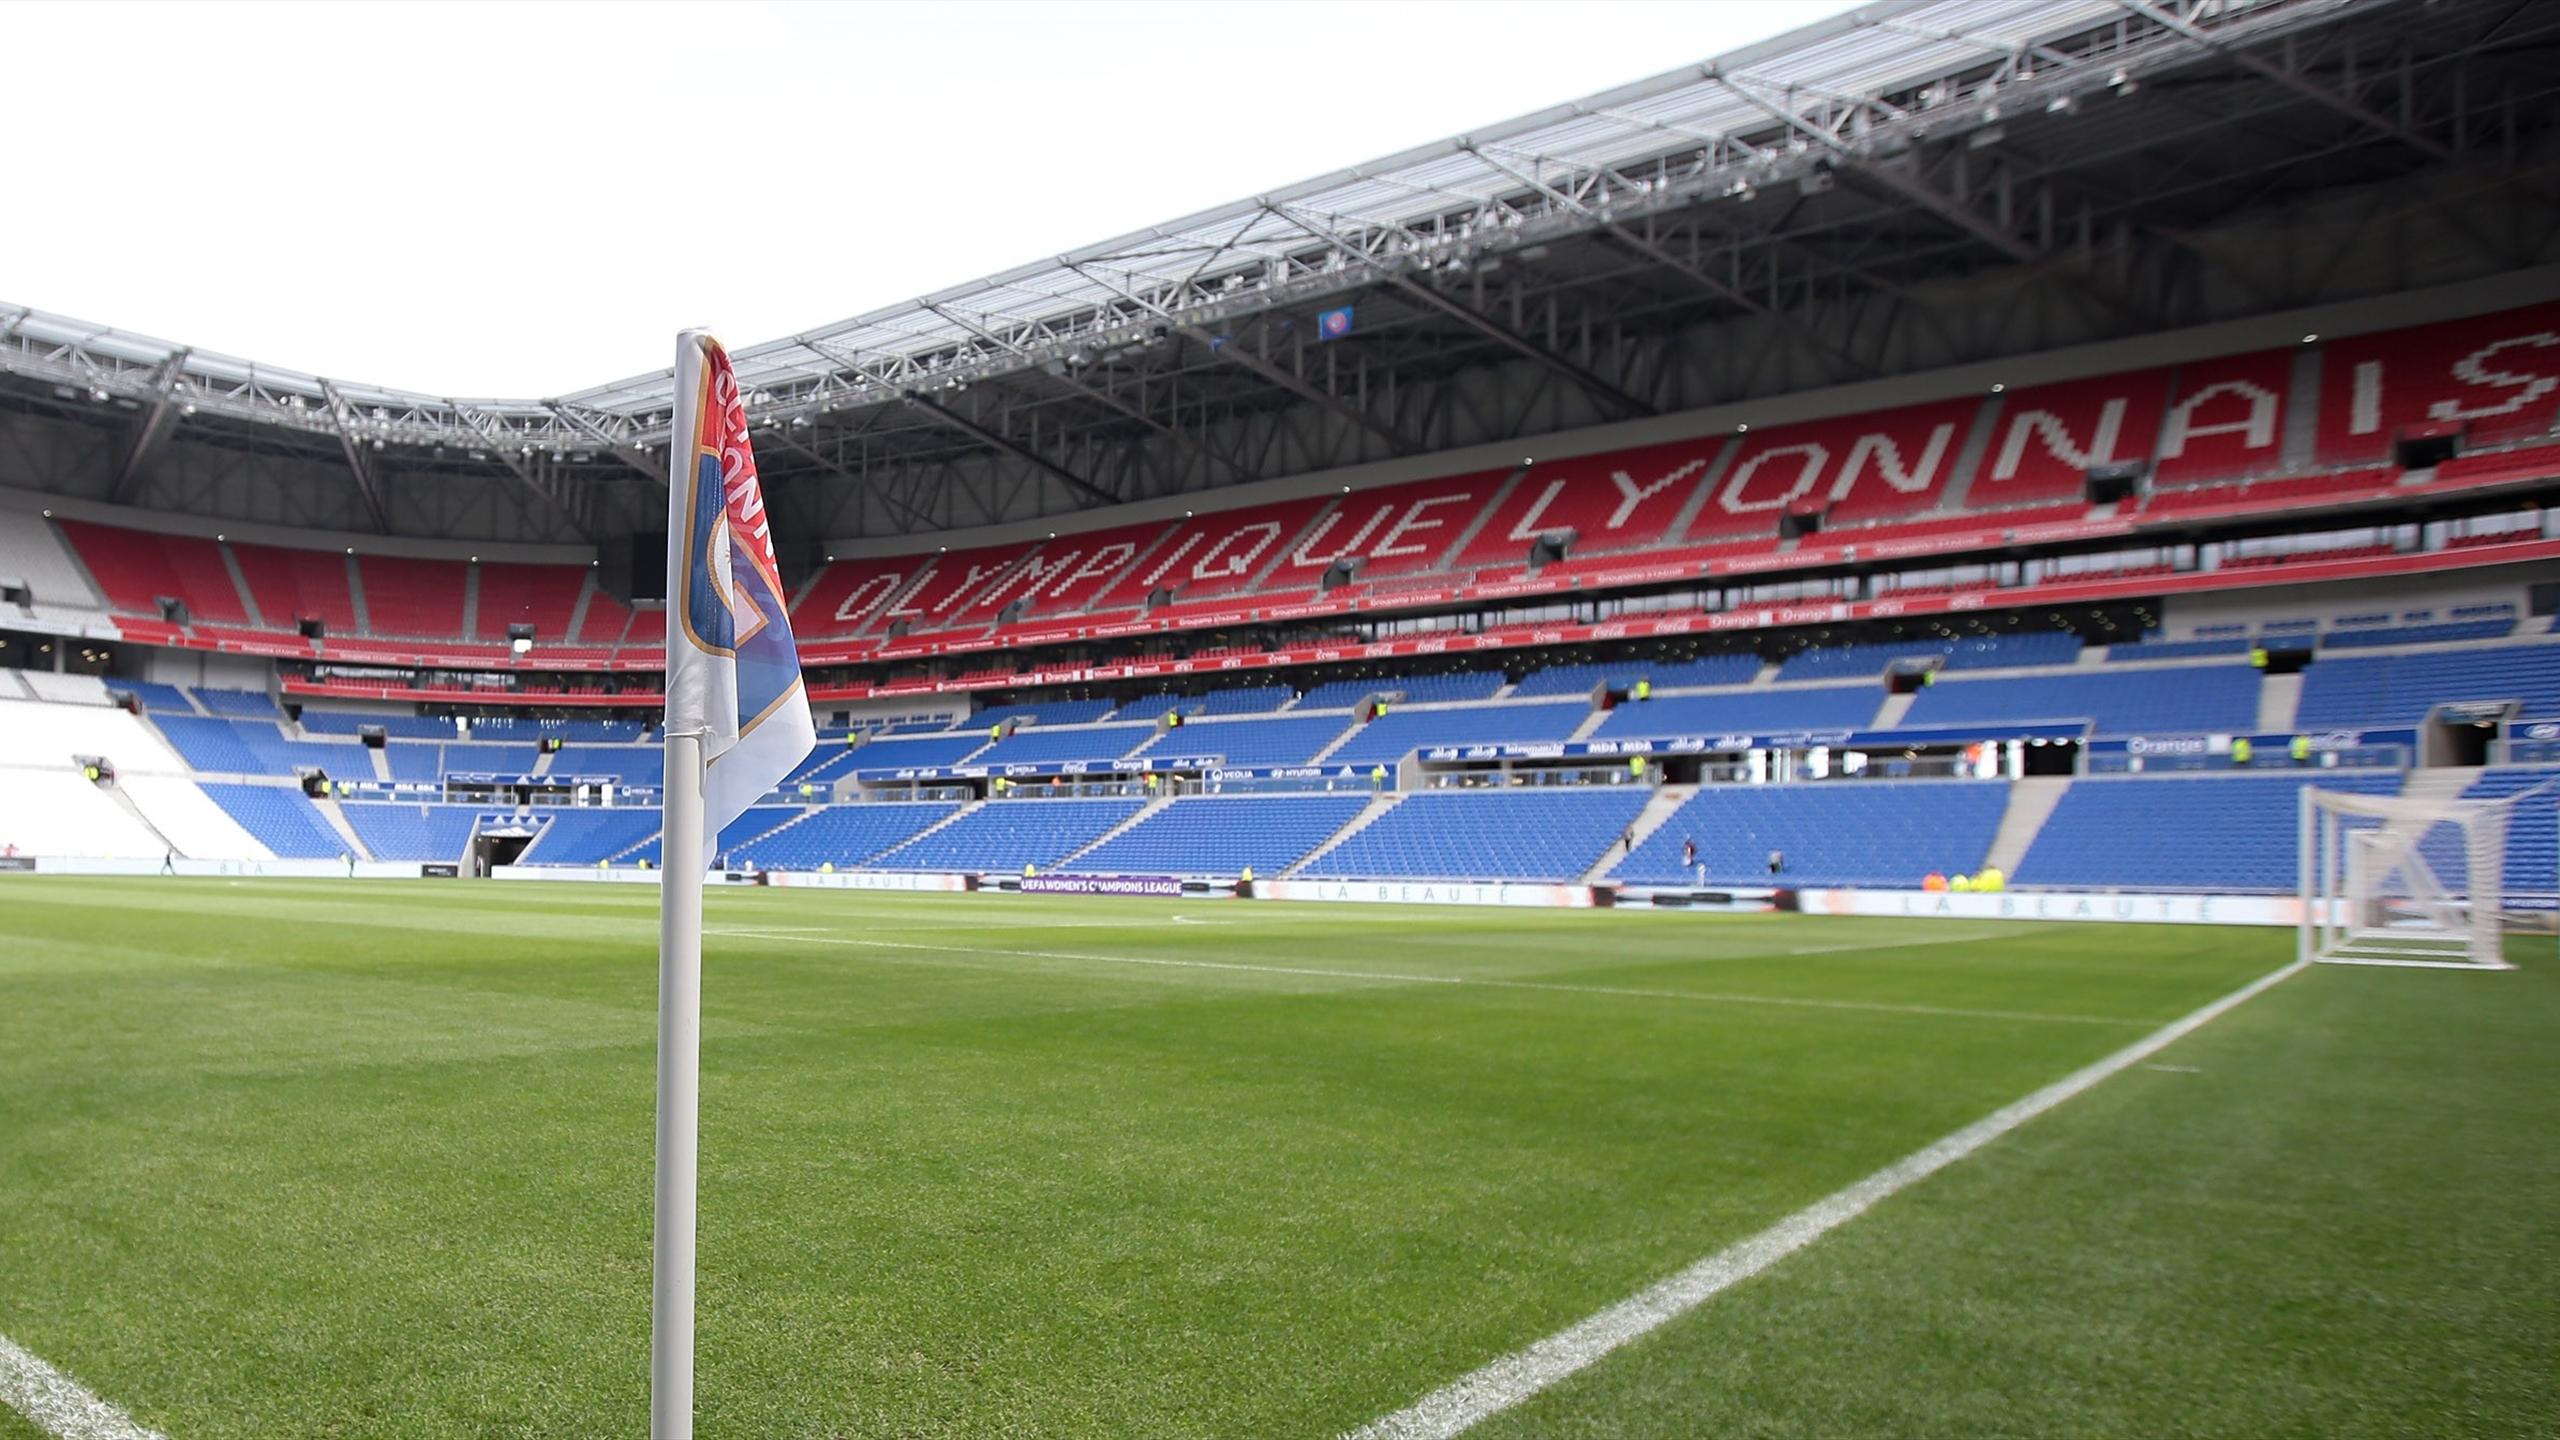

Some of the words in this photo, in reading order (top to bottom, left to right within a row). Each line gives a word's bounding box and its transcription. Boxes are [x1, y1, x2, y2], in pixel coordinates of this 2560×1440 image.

[836, 493, 1471, 620] OLYMPIQUE
[1509, 331, 2560, 541] LYONNAIS
[1008, 674, 1034, 685] Orange
[1046, 671, 1072, 682] Orange
[1112, 760, 1142, 771] Orange
[1224, 770, 1253, 778] VEOLIA
[1286, 768, 1322, 777] HYUNDAI
[1021, 880, 1045, 890] UEFA
[1046, 880, 1086, 891] WOMEN'S
[1144, 882, 1182, 893] LEAGUE
[1318, 885, 1348, 899] LA
[1379, 884, 1507, 904] BEAUTÉ
[1905, 896, 1950, 914] LA
[2001, 894, 2210, 921] BEAUTÉ
